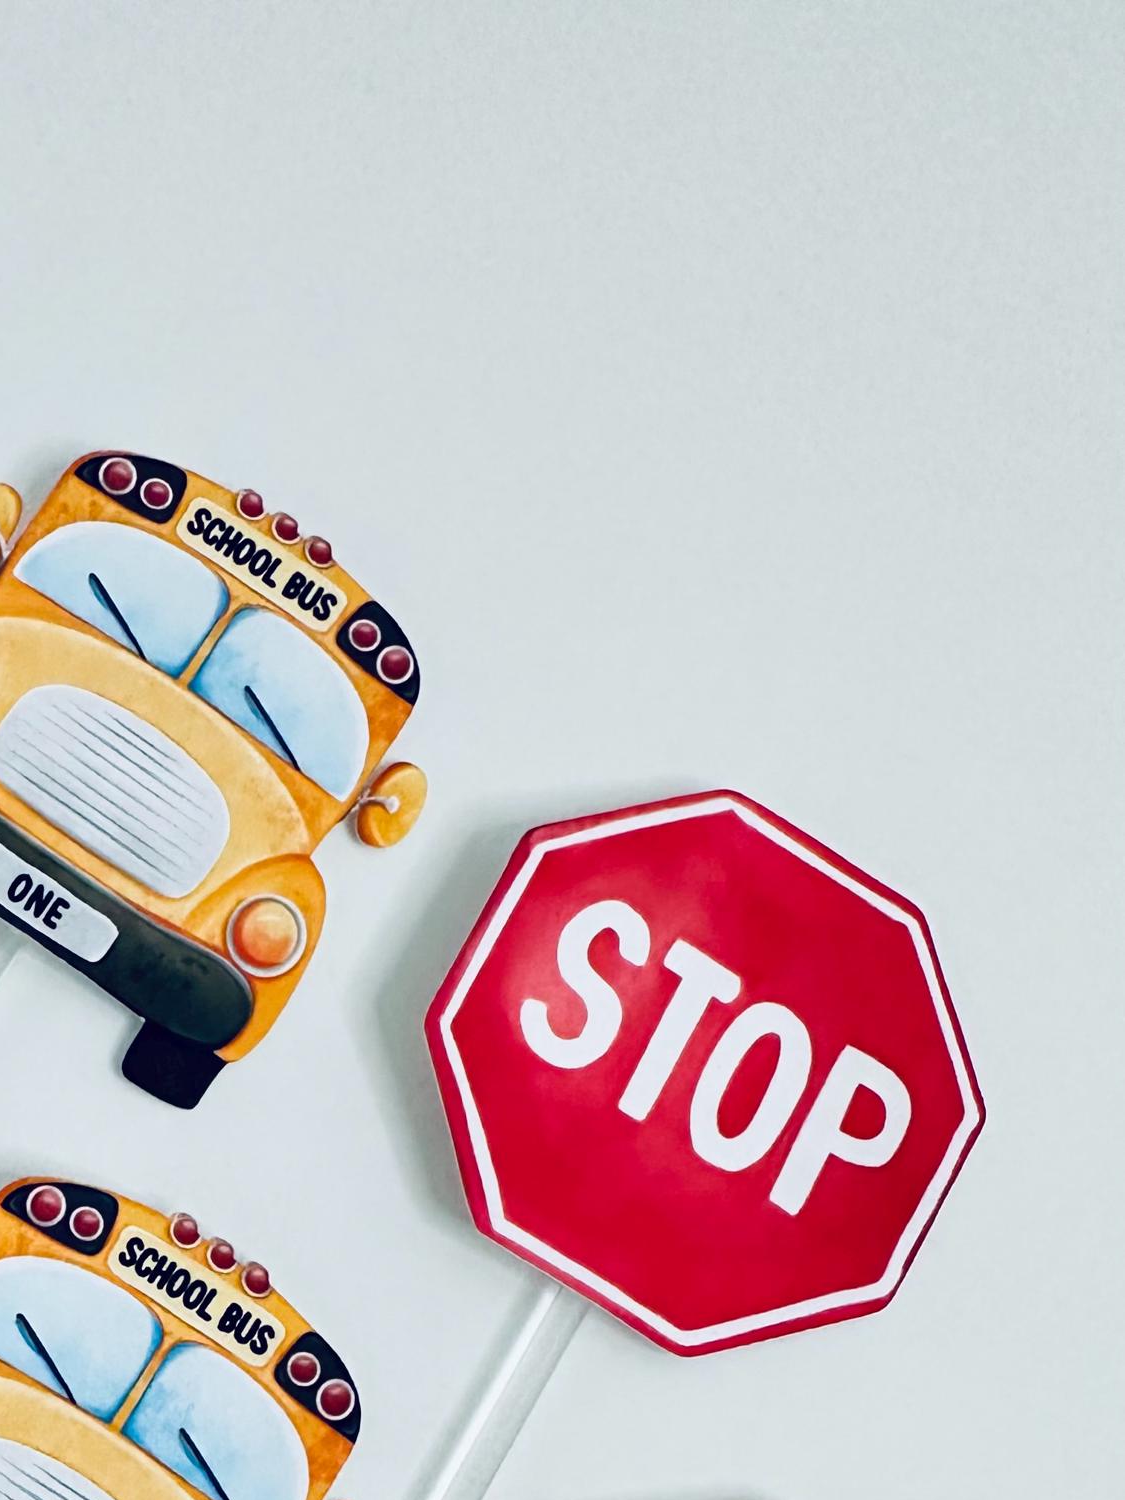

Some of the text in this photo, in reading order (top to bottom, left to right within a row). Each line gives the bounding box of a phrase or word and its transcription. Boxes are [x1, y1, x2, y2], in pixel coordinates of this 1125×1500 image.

[187, 508, 338, 621] SCHOOL BUS
[7, 873, 71, 930] ONE
[519, 900, 912, 1217] STOP
[118, 1237, 275, 1355] SCHOOL BUS
